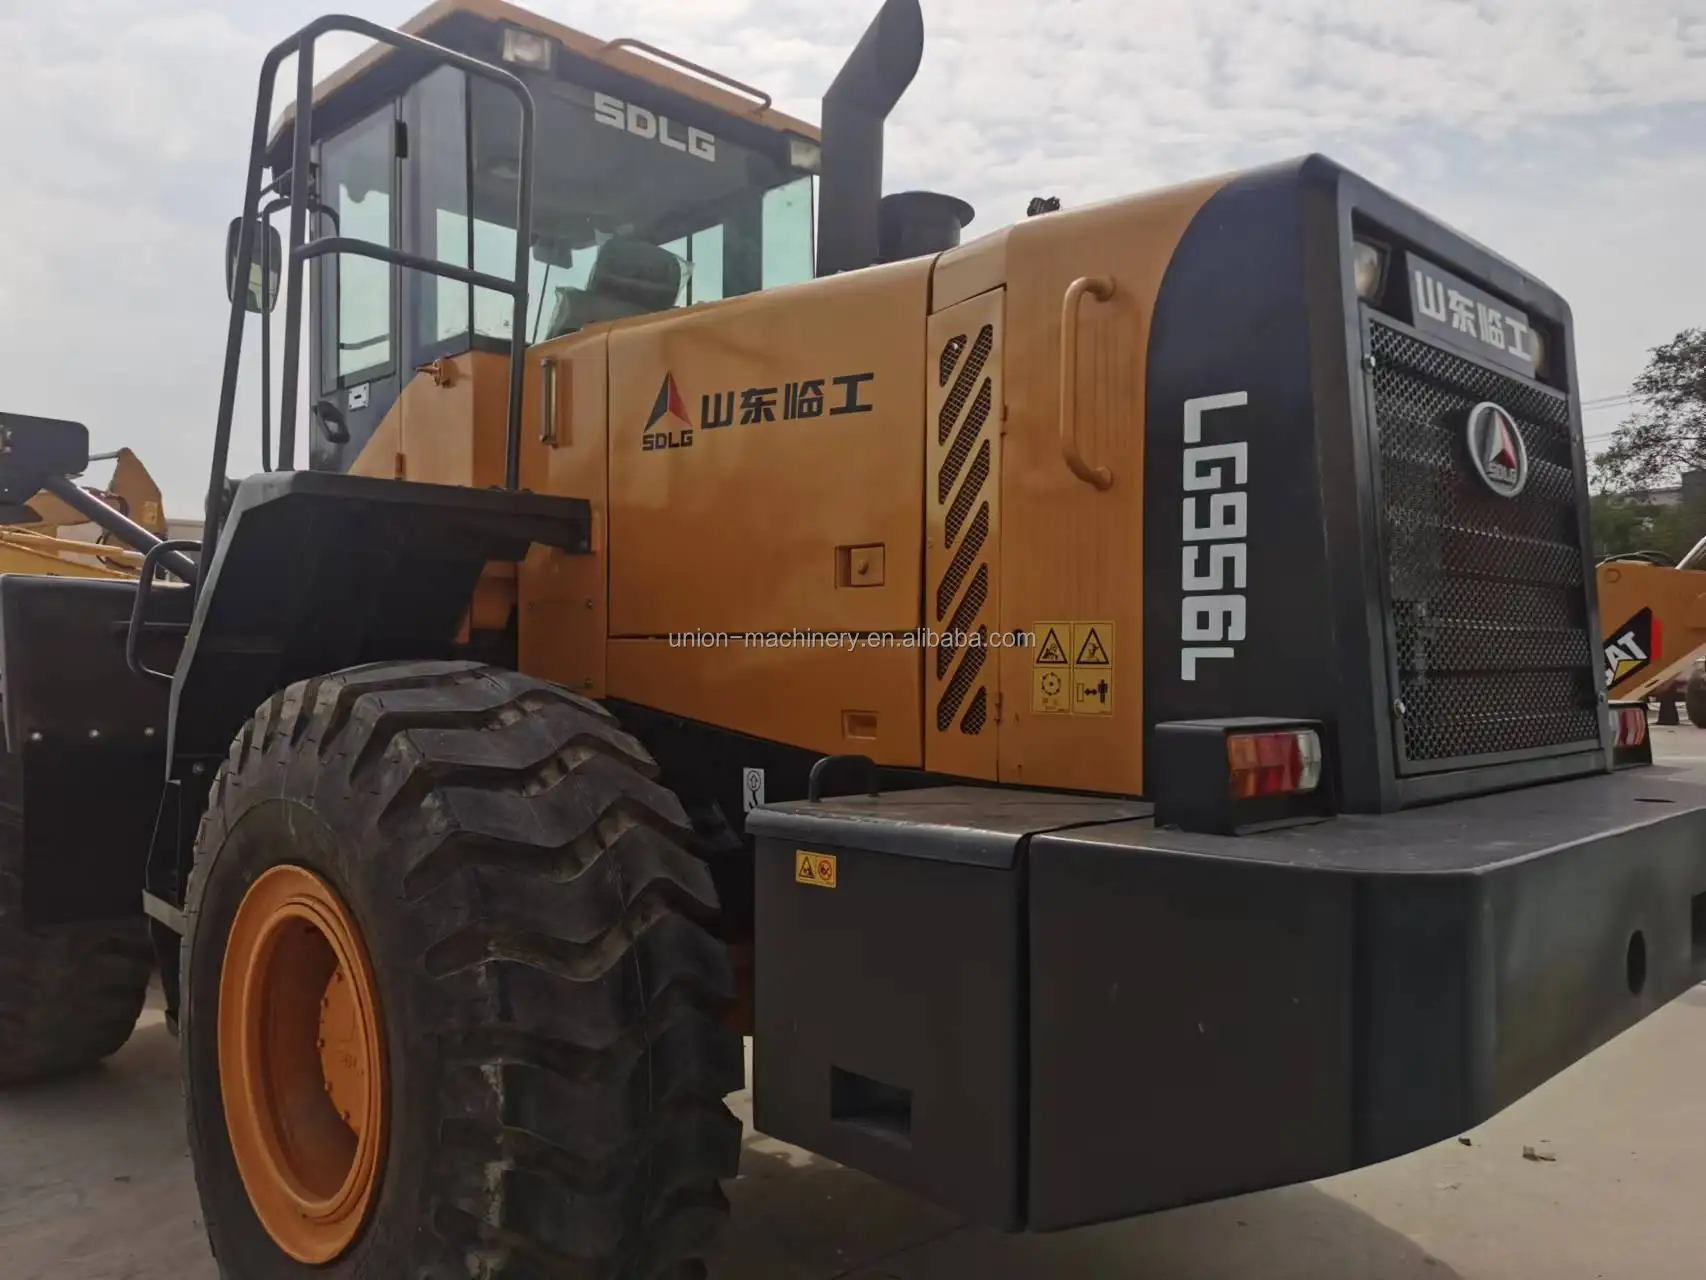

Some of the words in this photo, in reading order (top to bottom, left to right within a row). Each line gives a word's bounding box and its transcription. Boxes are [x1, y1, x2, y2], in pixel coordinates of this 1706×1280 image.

[594, 91, 716, 162] SDLG
[1414, 270, 1533, 362] 山东临工
[700, 372, 874, 430] 山东临工
[642, 429, 693, 451] SDLG
[1181, 391, 1248, 681] LG956L
